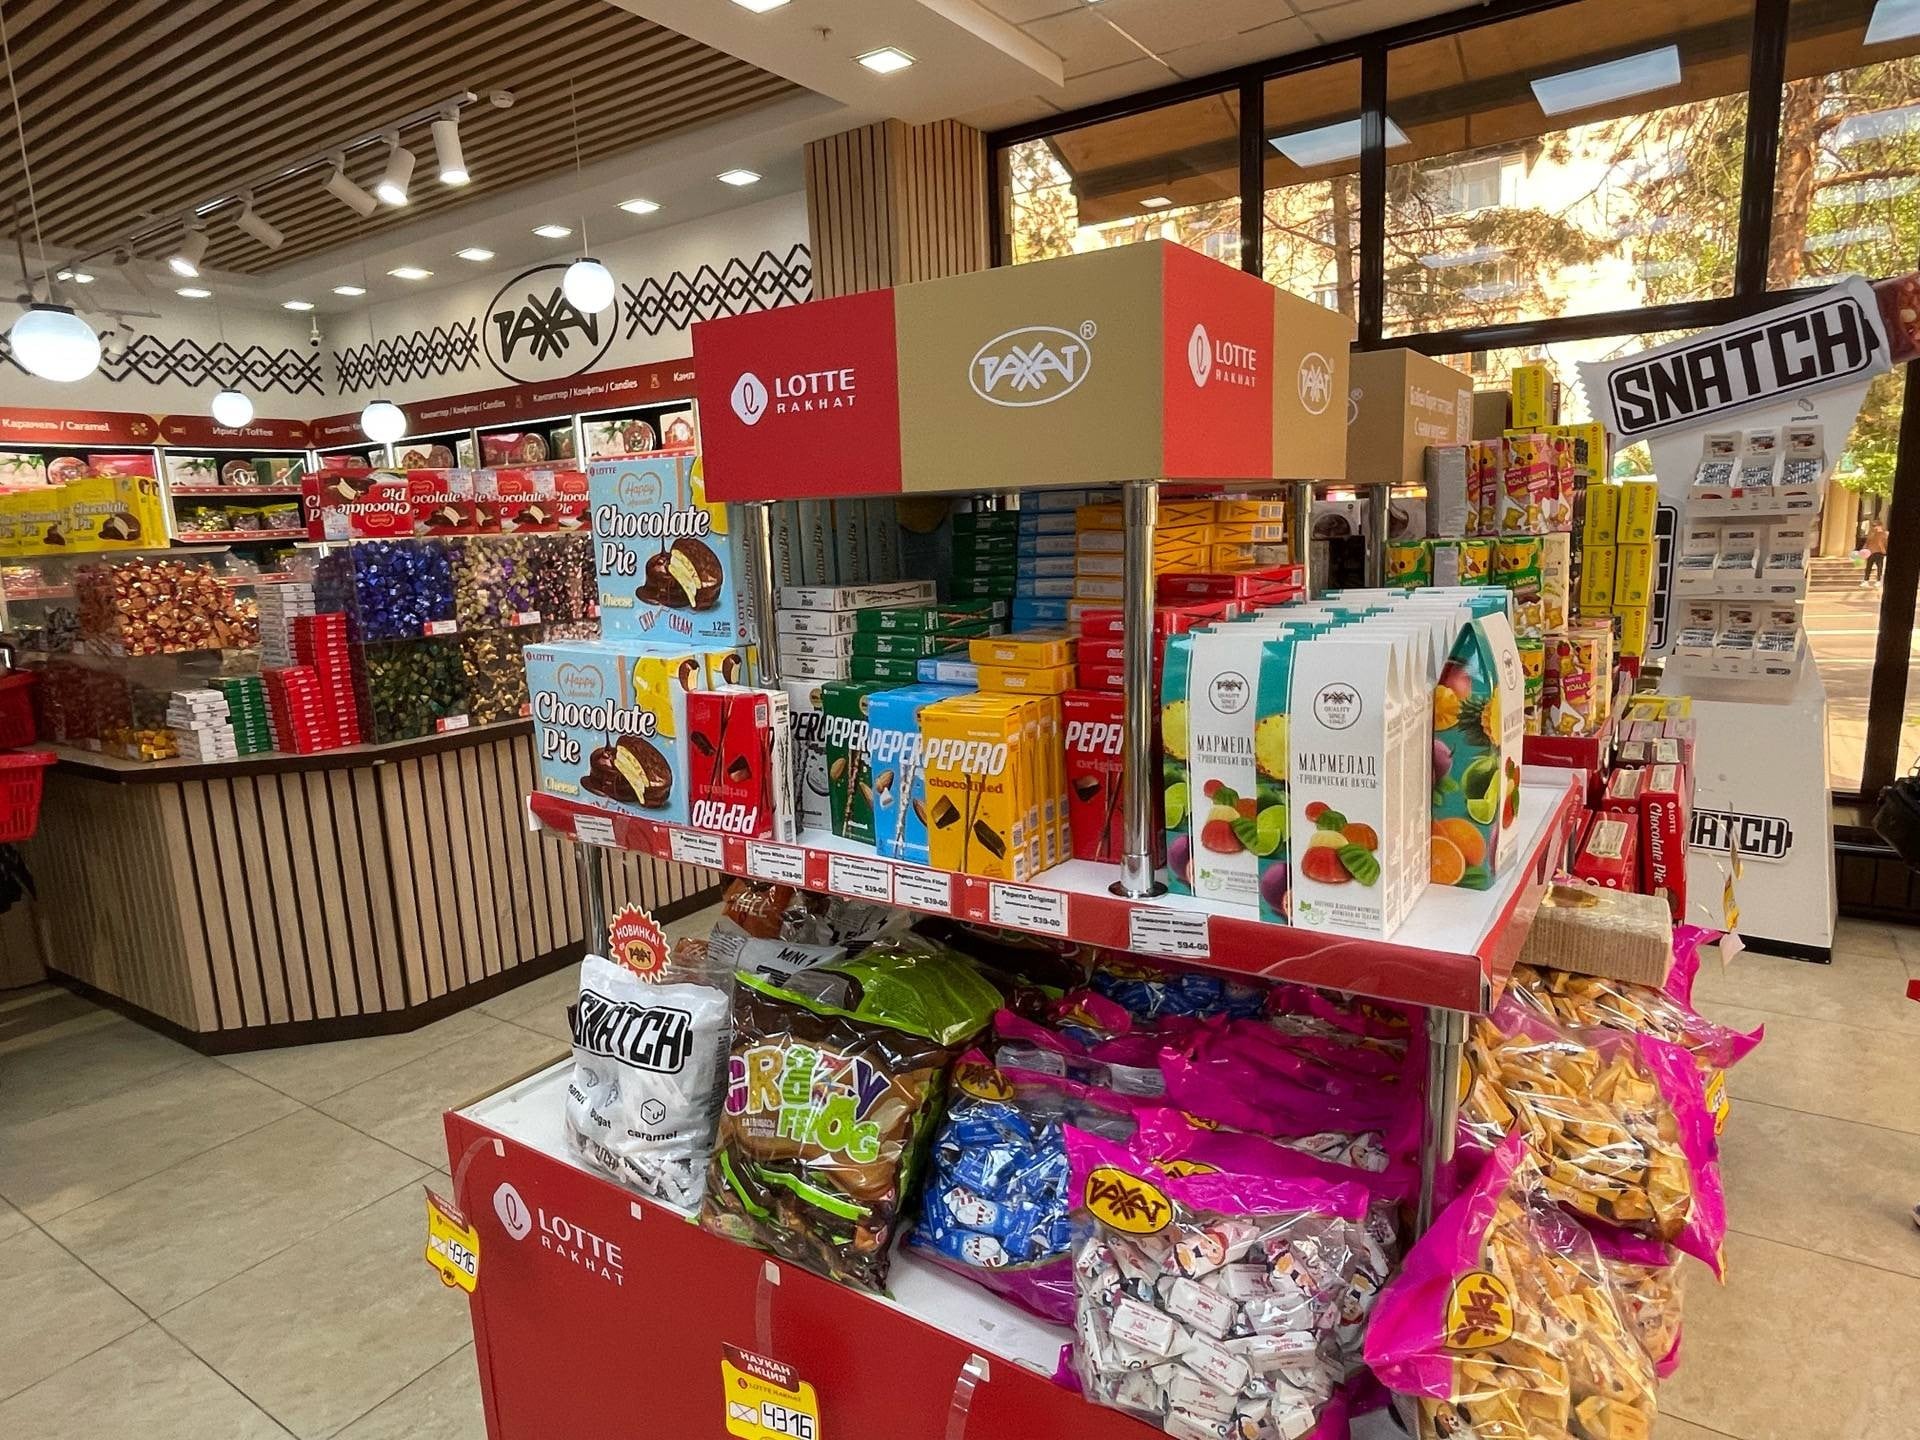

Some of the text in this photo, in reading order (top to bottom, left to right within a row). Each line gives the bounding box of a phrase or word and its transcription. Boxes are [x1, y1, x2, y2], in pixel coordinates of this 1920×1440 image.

[1216, 339, 1257, 371] LOTTE
[1614, 303, 1864, 430] SNATCH
[573, 383, 604, 397] Конфеты
[609, 379, 638, 391] Candies
[775, 368, 856, 398] LOTTE
[1216, 368, 1256, 388] RAKHAT
[776, 395, 856, 414] RAKHAT
[2, 418, 58, 430] Карамель
[66, 420, 110, 432] Caramel
[212, 426, 238, 436] Ирис
[245, 427, 274, 436] Toffee
[595, 467, 617, 475] LOTTE
[382, 487, 407, 501] Pie
[411, 490, 460, 504] ocolate
[498, 490, 545, 503] ocolate
[337, 501, 411, 516] Chocolate
[595, 502, 712, 538] Chocolate
[600, 541, 637, 577] Pie
[532, 653, 555, 662] LOTTE
[565, 672, 596, 689] Happy
[534, 690, 657, 738] Chocolate
[824, 714, 870, 752] PEPER
[1064, 720, 1124, 755] PEPE
[542, 726, 581, 765] Pie
[869, 727, 923, 766] PEPER
[1197, 734, 1253, 755] МАРМЕЛА
[923, 737, 1009, 776] PEPERO
[1076, 758, 1123, 773] origin
[1298, 753, 1377, 777] МАРМЕЛАД
[545, 776, 579, 795] Cheese
[1299, 773, 1377, 789] ТРОПИЧЕСКИЕ ВКУСЫ
[692, 799, 758, 835] PEPERO
[1668, 811, 1677, 833] LOTTE
[1649, 802, 1667, 883] Chocolate Pie
[1690, 811, 1785, 855] ATCH
[851, 863, 870, 872] Almond
[914, 874, 931, 884] Choco
[932, 877, 948, 887] Filled
[924, 896, 948, 907] 539-00
[1001, 889, 1057, 905] Pepero Original
[1032, 916, 1061, 928] 539-00
[615, 924, 660, 946] НОВИНКА!
[777, 946, 807, 966] MINI
[1177, 941, 1209, 951] 594-00
[574, 993, 687, 1069] SNATCH
[627, 1127, 679, 1143] caramel
[538, 1207, 624, 1269] LOTTE
[449, 1239, 475, 1274] 4316
[541, 1235, 624, 1286] RAKHAT
[747, 1363, 787, 1384] АКЦИЯ
[763, 1404, 812, 1439] 4316
